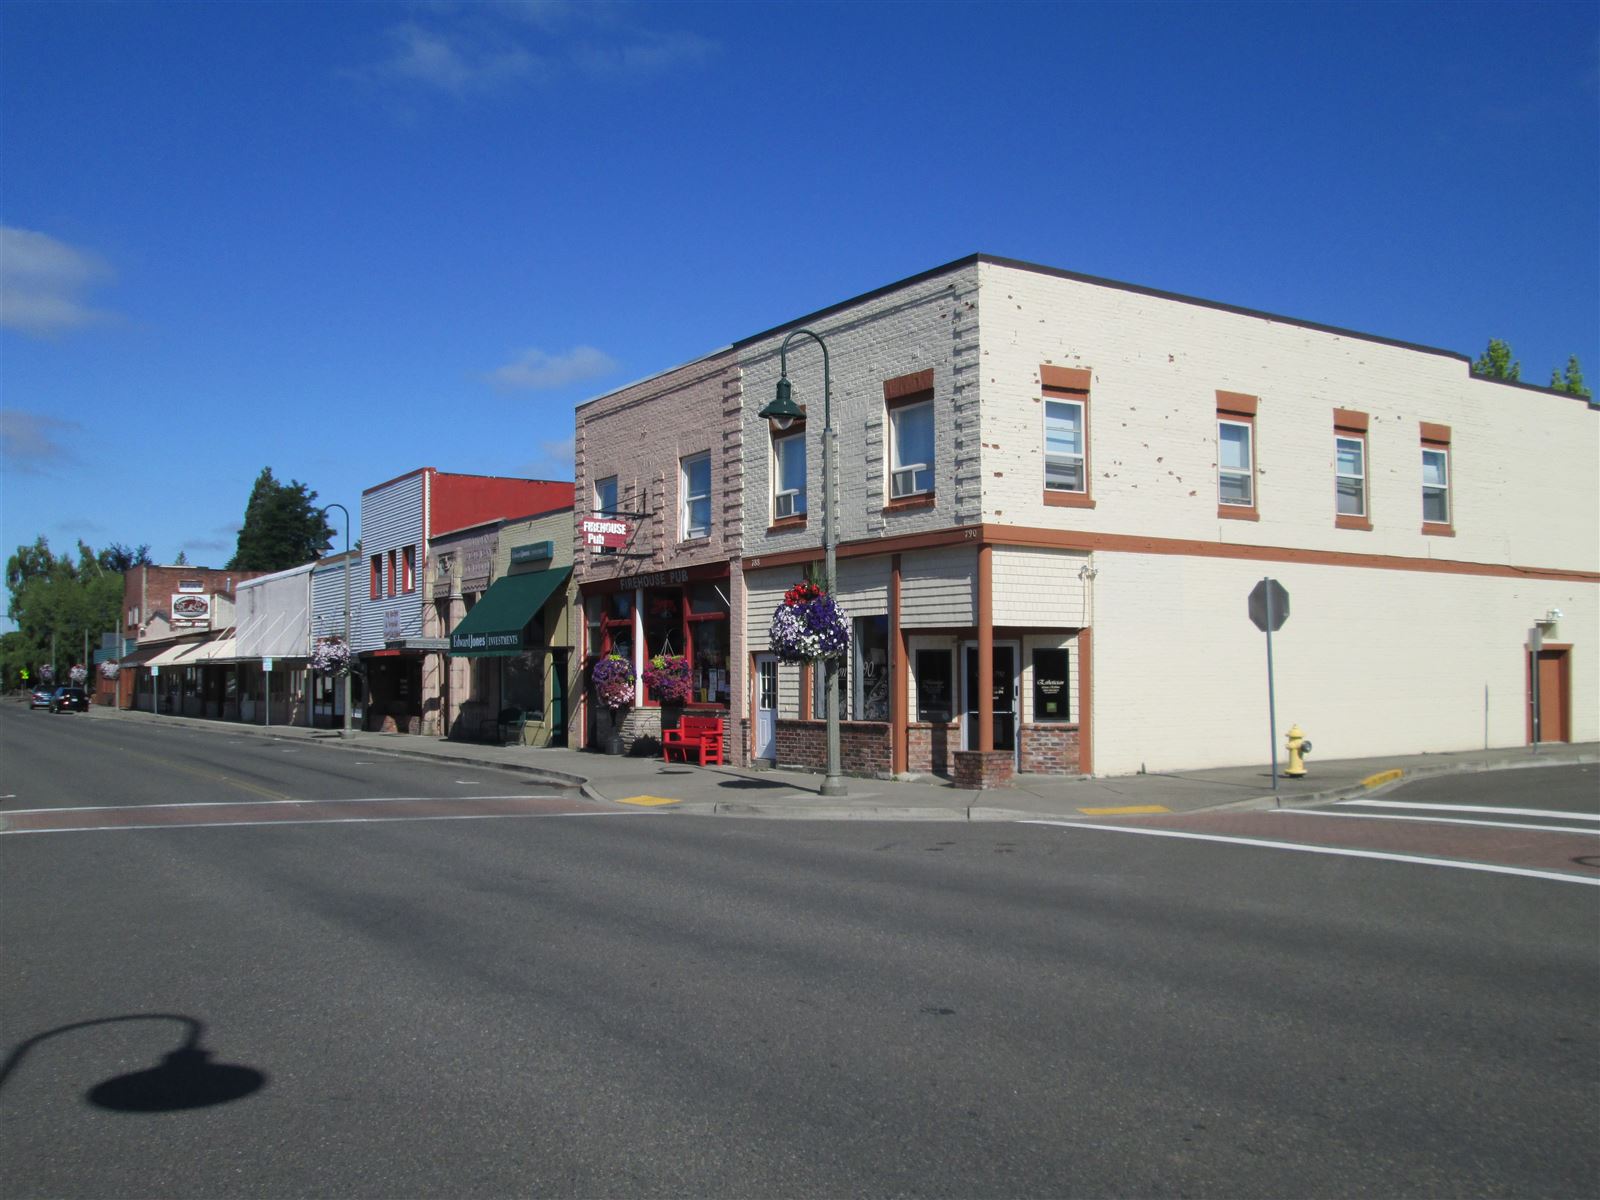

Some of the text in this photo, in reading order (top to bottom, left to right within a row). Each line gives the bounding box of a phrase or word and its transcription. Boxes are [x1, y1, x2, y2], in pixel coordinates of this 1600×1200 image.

[583, 521, 626, 535] FIREHOUSE
[587, 533, 605, 545] Pub
[620, 569, 689, 591] FIREHOUSE PUB
